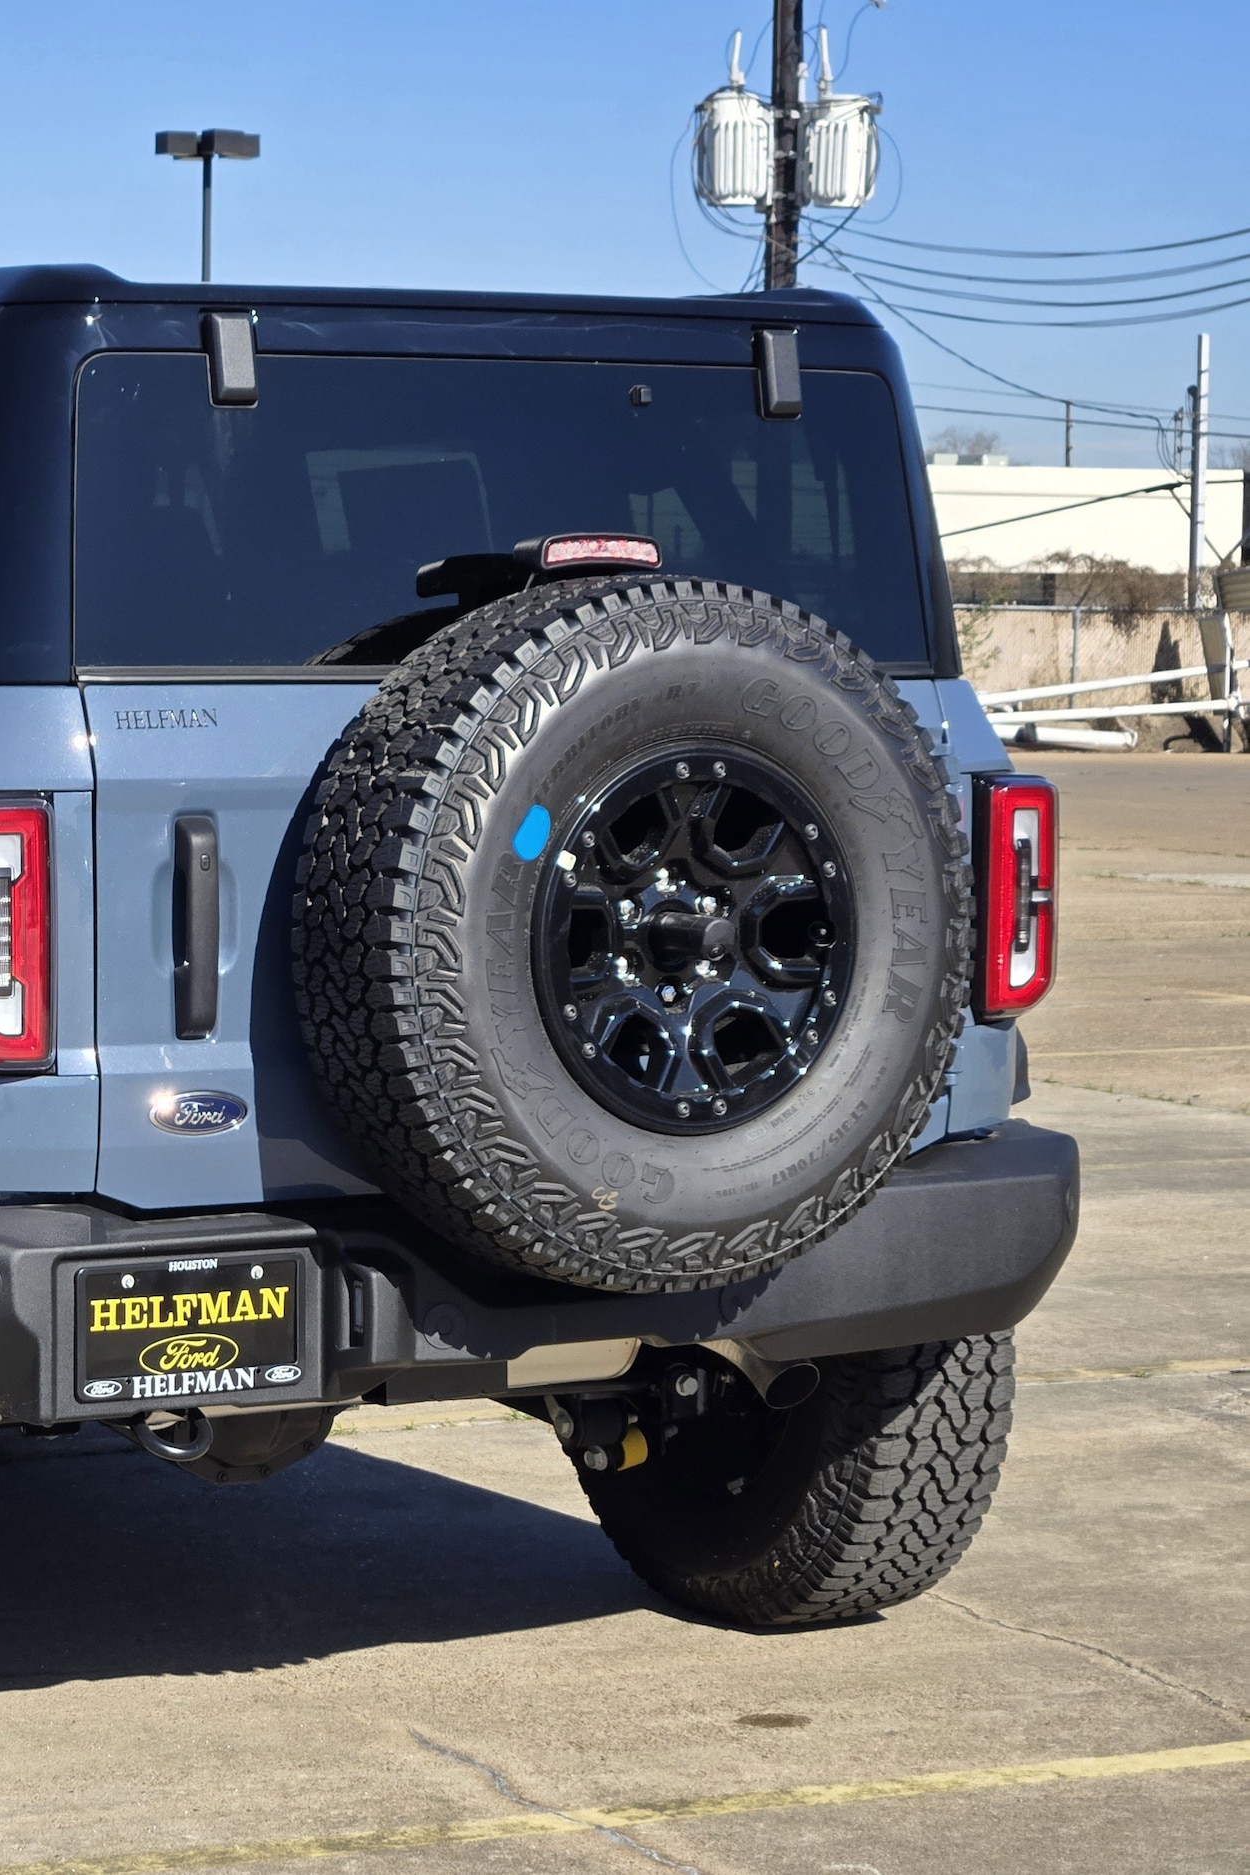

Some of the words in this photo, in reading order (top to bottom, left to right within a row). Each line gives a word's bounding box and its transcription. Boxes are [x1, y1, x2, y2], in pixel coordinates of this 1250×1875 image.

[114, 708, 219, 730] HELFMAN
[174, 1101, 226, 1126] Ford
[168, 1258, 218, 1272] HOUSTON
[89, 1286, 289, 1332] HELFMAN
[159, 1339, 221, 1370] Ford
[132, 1367, 257, 1399] HELFMAN
